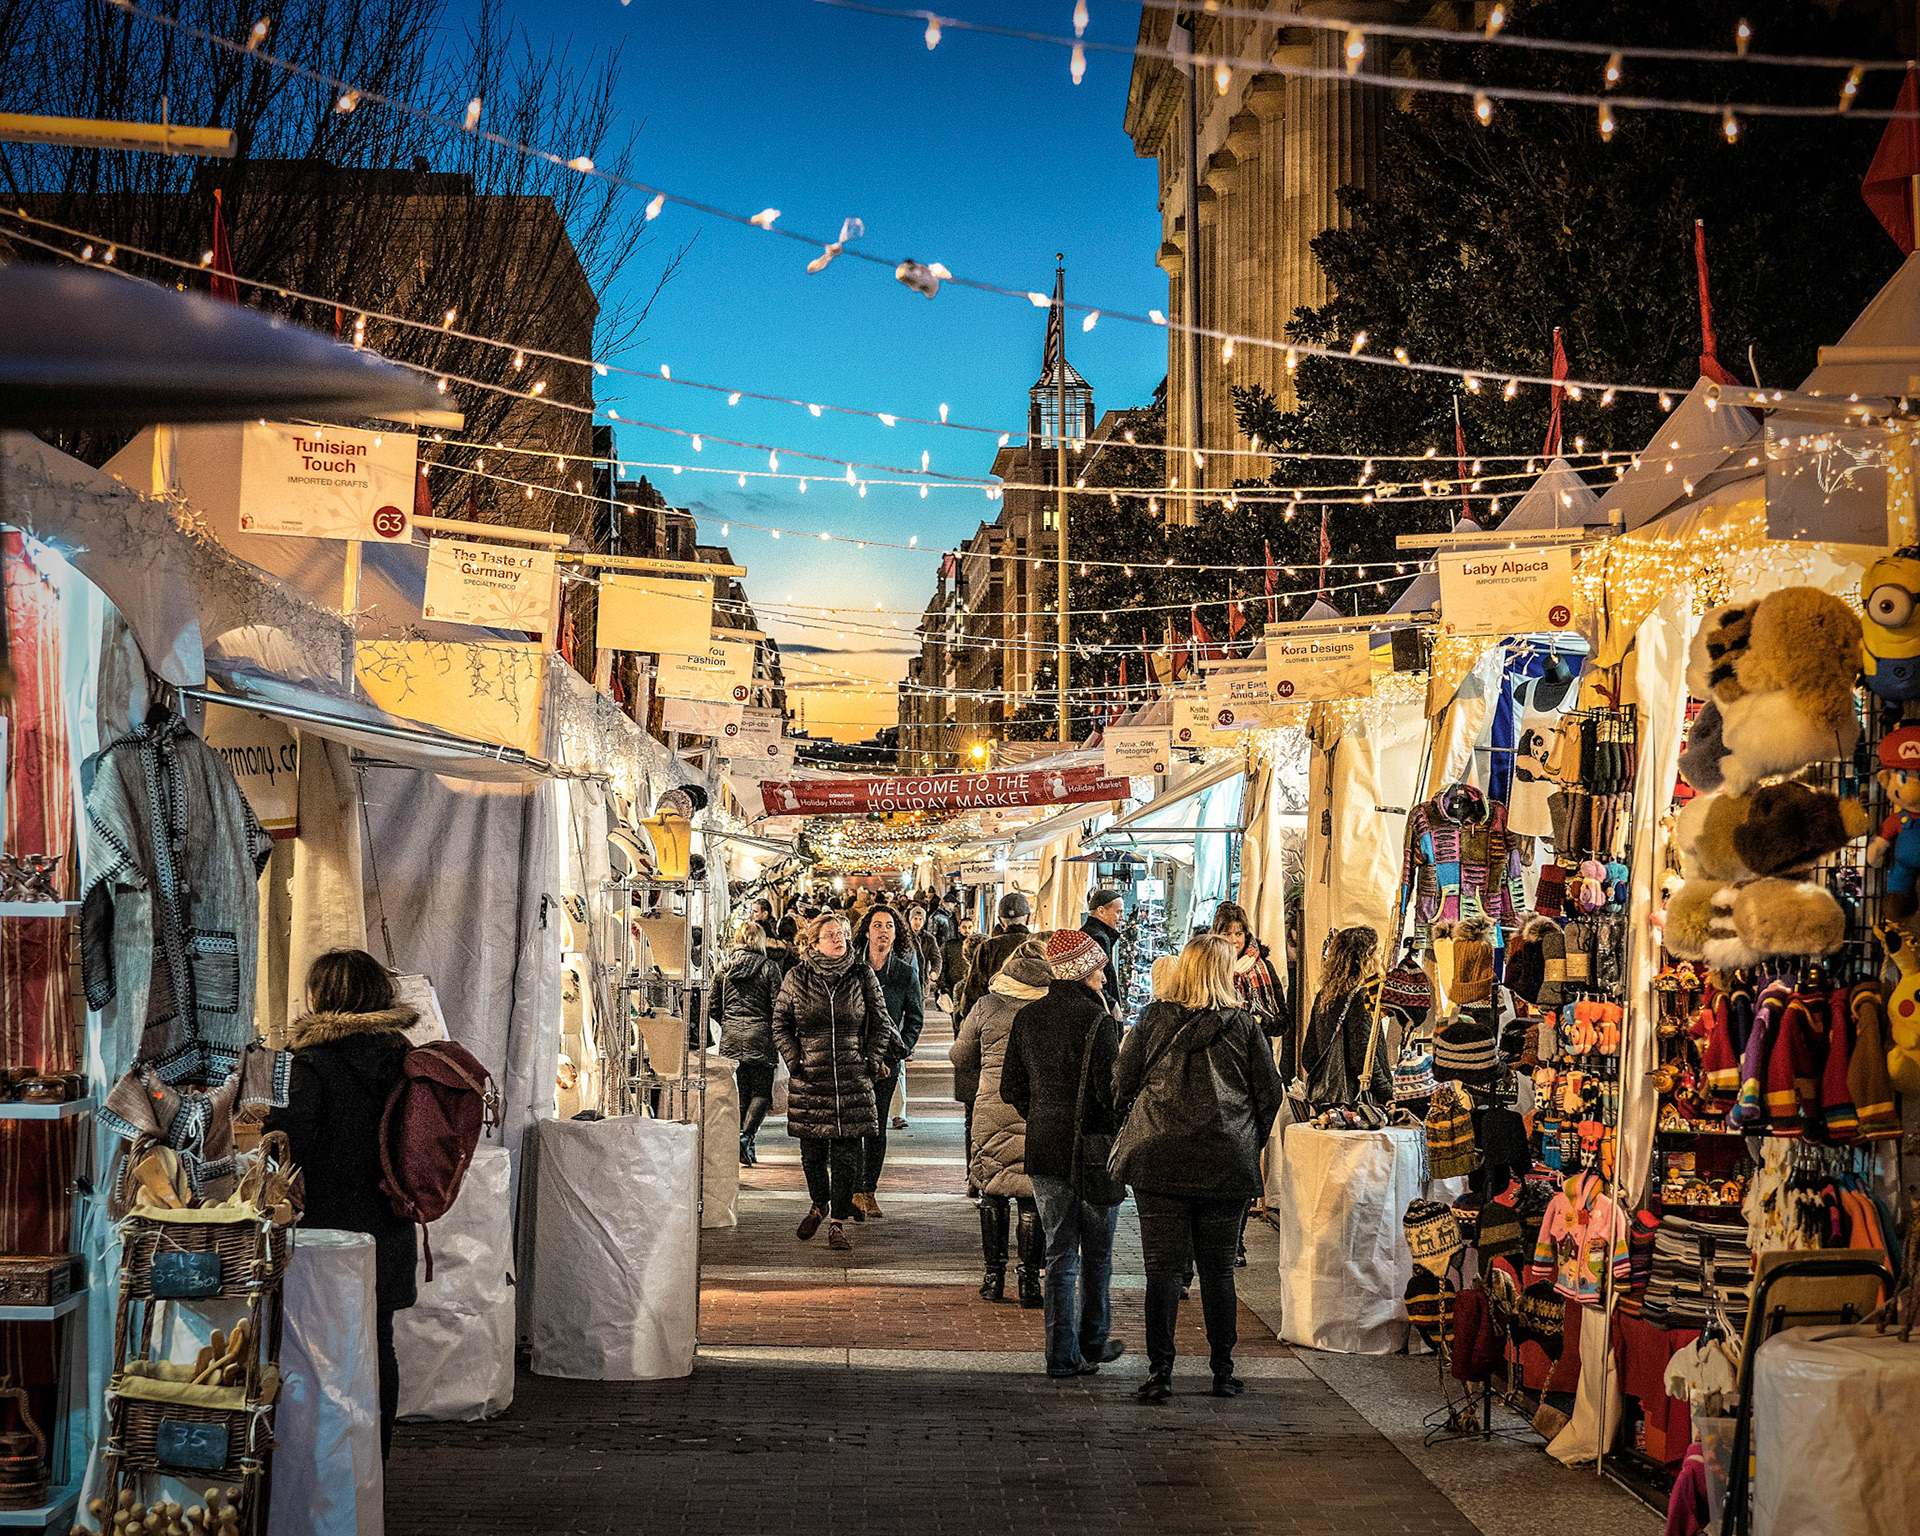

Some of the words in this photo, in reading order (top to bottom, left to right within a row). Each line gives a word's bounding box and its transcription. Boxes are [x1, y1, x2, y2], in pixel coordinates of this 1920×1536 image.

[292, 437, 367, 456] Tunisian
[301, 456, 356, 473] Touch
[287, 476, 333, 486] IMPORTED
[334, 479, 369, 489] CRAFTS
[376, 513, 402, 532] 63
[452, 547, 477, 561] The
[481, 551, 516, 567] Taste
[519, 558, 534, 568] of
[461, 563, 521, 582] Germany
[1462, 563, 1498, 577] Baby
[1501, 561, 1549, 574] Alpaca
[463, 579, 497, 588] SPECIALTY
[1475, 577, 1510, 586] IMPORTED
[1511, 575, 1537, 584] CRAFTS
[1551, 610, 1568, 622] 45
[1281, 644, 1307, 655] Kora
[1310, 643, 1354, 655] Designs
[687, 655, 726, 666] Fashion
[1230, 682, 1245, 691] Far
[1247, 680, 1268, 690] East
[1279, 684, 1293, 694] 44
[734, 688, 747, 698] 61
[1229, 690, 1270, 700] Antiques
[1218, 713, 1232, 722] 43
[725, 726, 737, 734] 60
[1180, 731, 1190, 739] 42
[1115, 747, 1159, 755] Photography
[1903, 744, 1919, 756] M
[867, 779, 959, 797] WELCOME
[965, 777, 990, 791] TO
[996, 775, 1030, 790] THE
[1068, 784, 1096, 793] Holiday
[1096, 780, 1122, 790] Market
[800, 798, 828, 808] Holiday
[828, 798, 855, 807] Market
[866, 796, 948, 811] HOLIDAY
[956, 791, 1030, 808] MARKET
